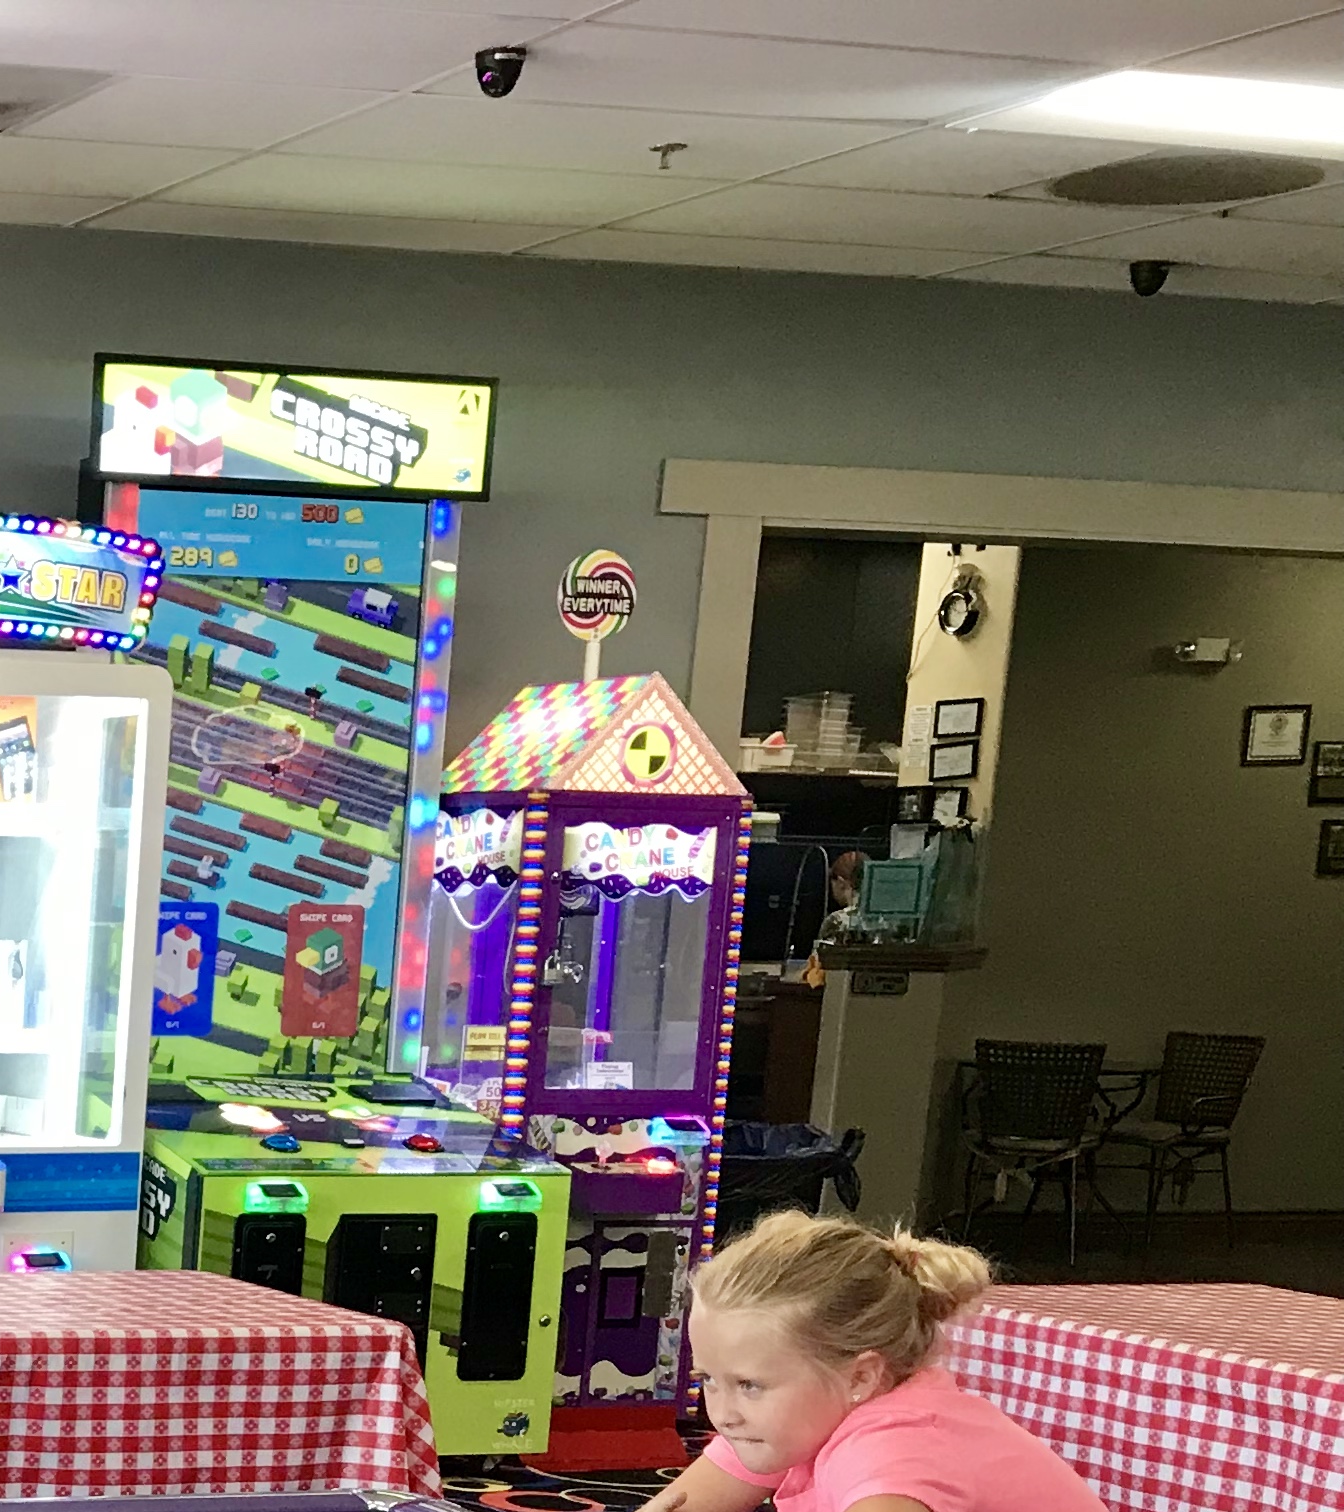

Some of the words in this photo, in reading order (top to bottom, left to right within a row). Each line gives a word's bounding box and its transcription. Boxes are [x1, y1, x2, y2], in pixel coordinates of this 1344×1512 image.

[270, 388, 420, 465] CROSSY
[294, 425, 394, 485] ROAD
[231, 503, 258, 520] 130
[301, 503, 339, 523] 500
[170, 546, 214, 568] 289
[31, 560, 128, 613] STAR
[576, 579, 621, 594] WINNER
[563, 597, 631, 614] EVERYTIME
[435, 810, 482, 841] CANDY
[446, 832, 493, 860] CRANE
[585, 826, 656, 852] CANDY
[477, 851, 505, 865] HOUSE
[604, 847, 675, 872] CRANE
[654, 865, 694, 879] HOUSE
